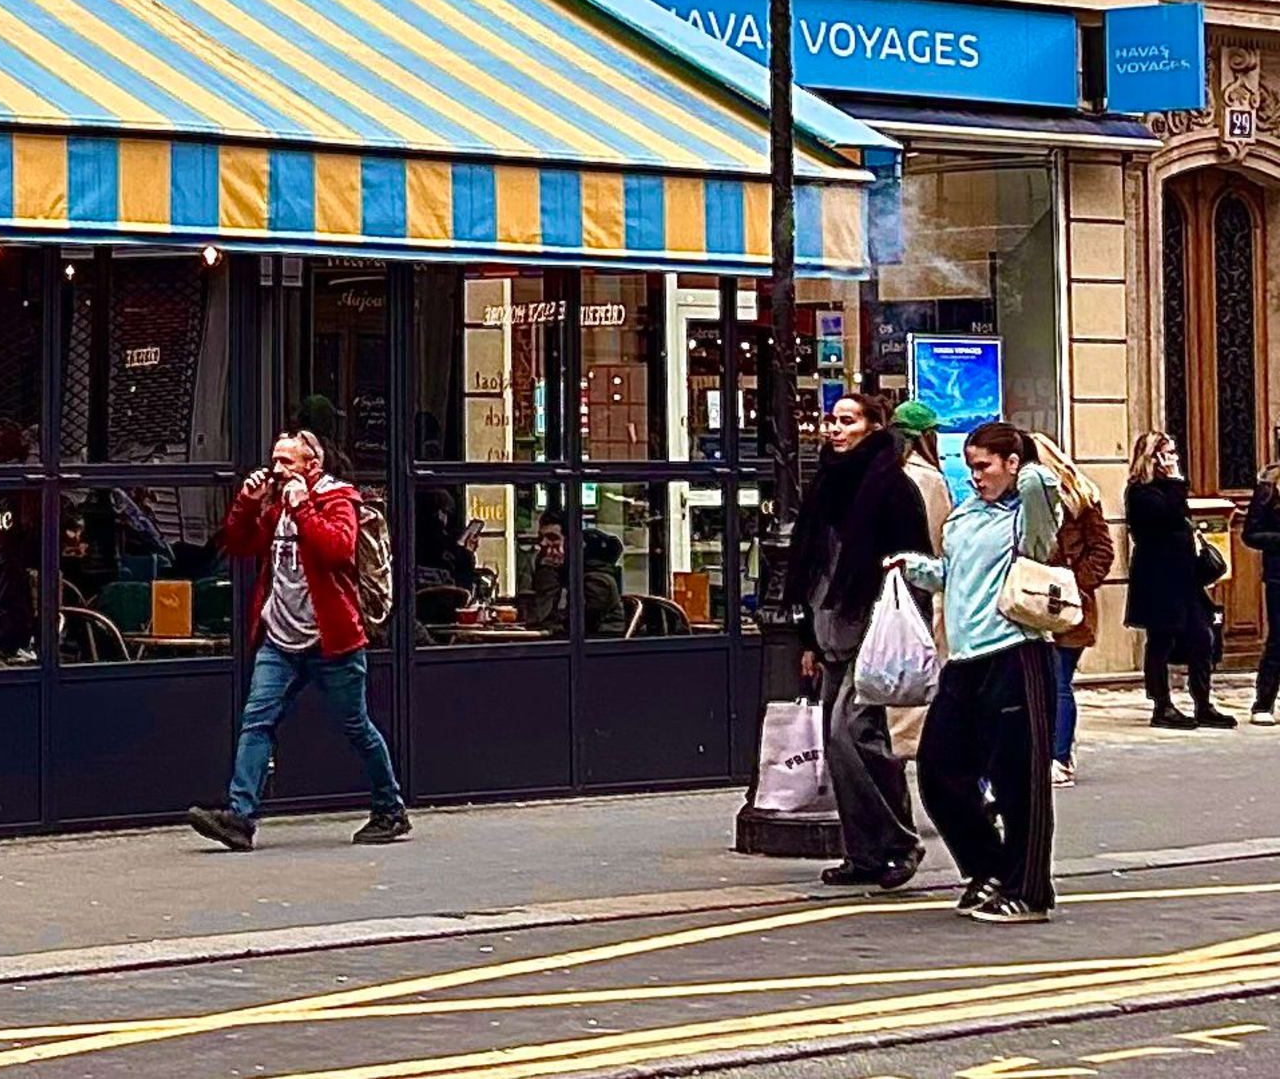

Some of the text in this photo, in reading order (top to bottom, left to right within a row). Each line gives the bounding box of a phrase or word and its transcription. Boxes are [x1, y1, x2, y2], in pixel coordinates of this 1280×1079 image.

[799, 19, 980, 69] VOYAGES
[1115, 44, 1170, 59] HAVAS
[1232, 112, 1251, 135] 29
